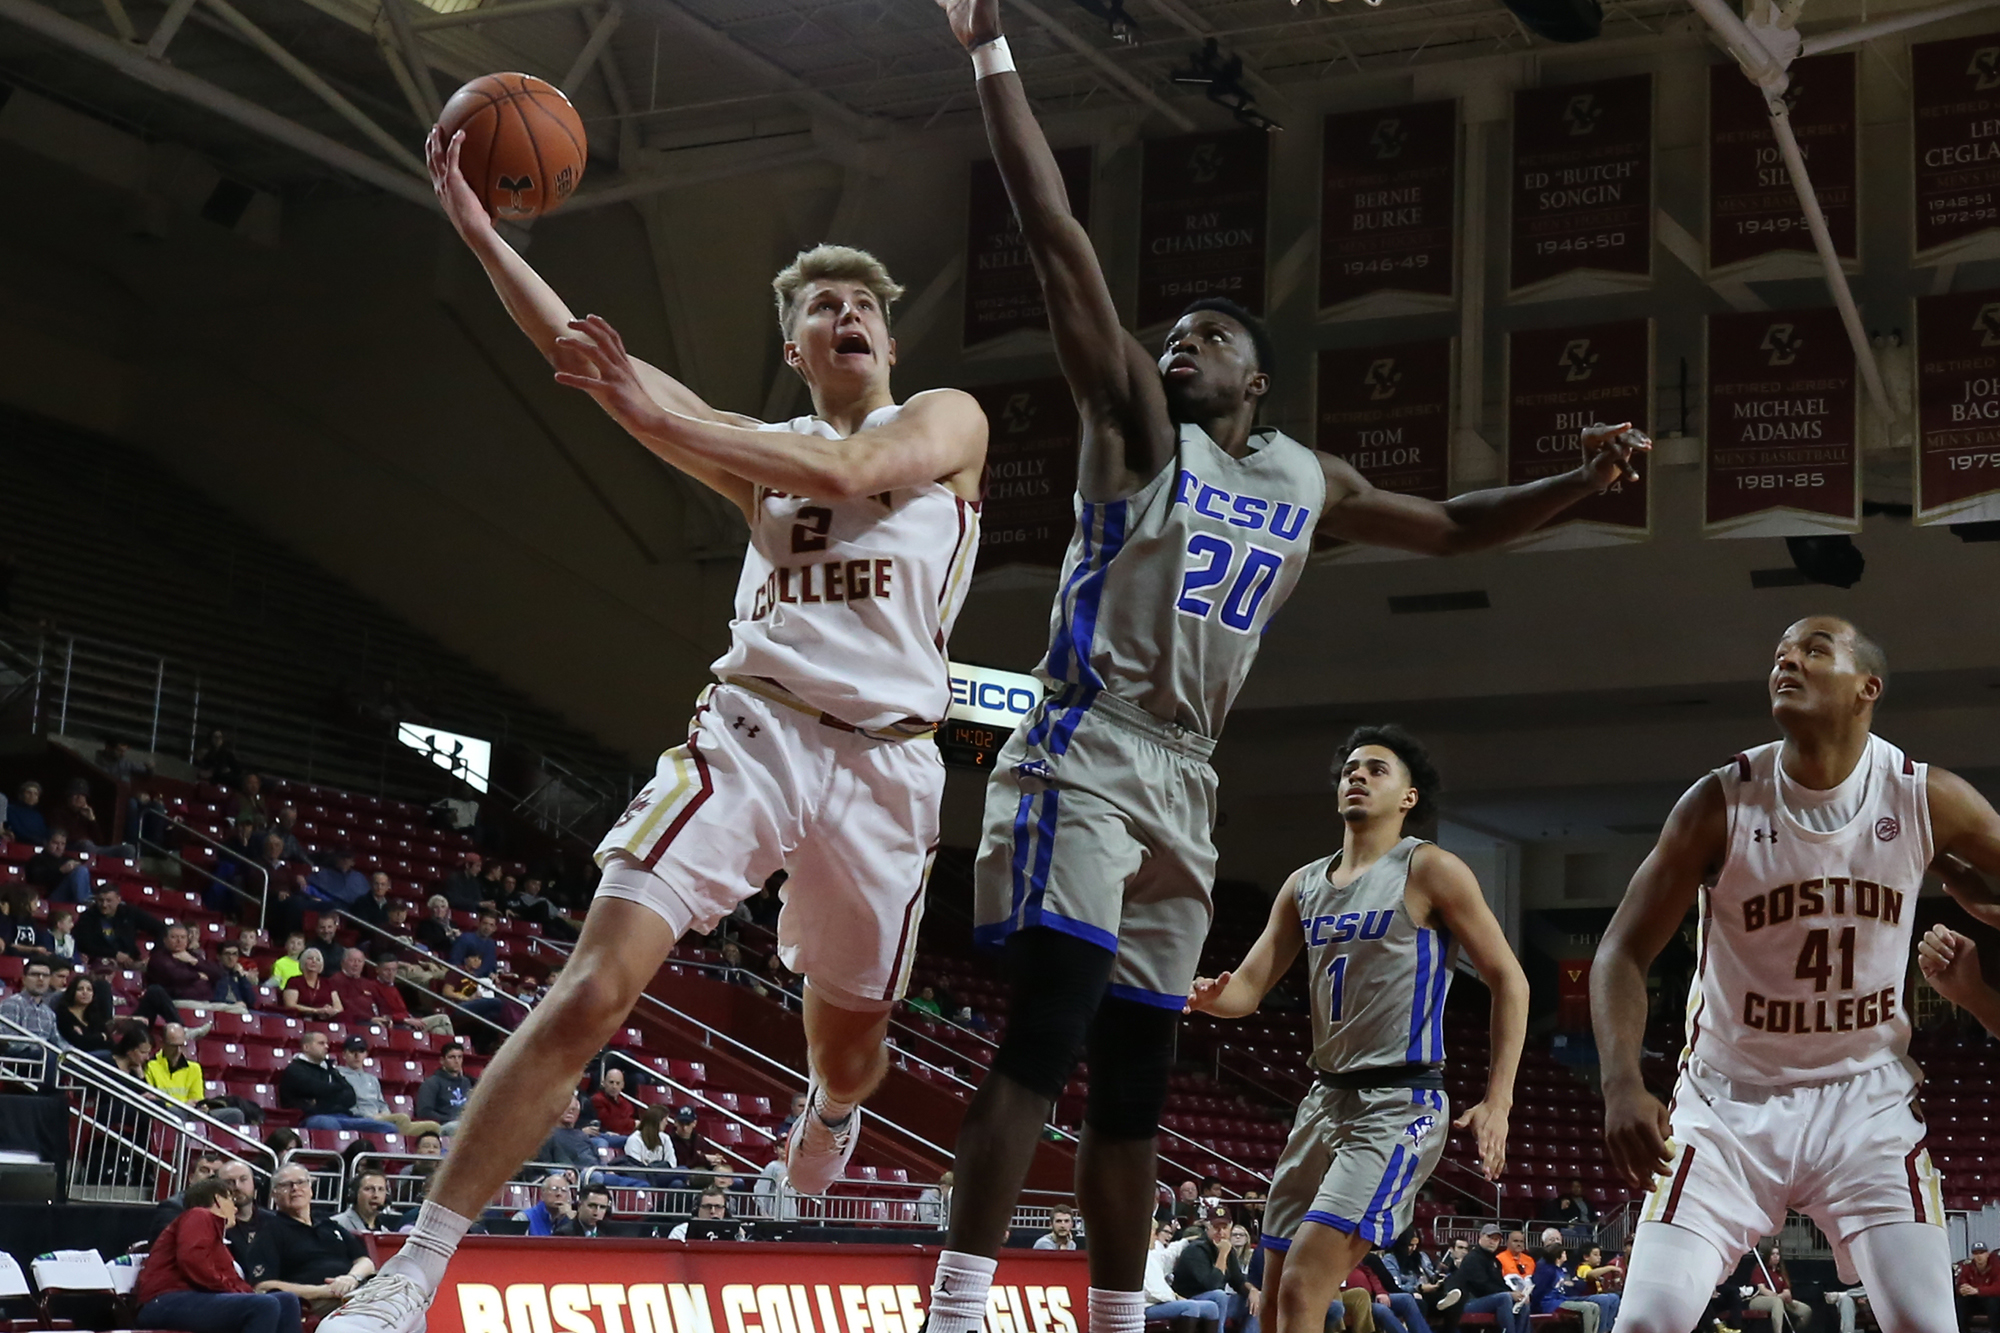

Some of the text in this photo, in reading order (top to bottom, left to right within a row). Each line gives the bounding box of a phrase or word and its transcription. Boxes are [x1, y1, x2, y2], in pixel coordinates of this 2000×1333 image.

[1716, 123, 1848, 143] RETIRE ERSEY
[1524, 172, 1549, 190] ED
[1758, 167, 1791, 187] SIL
[1354, 187, 1421, 209] BERNIE
[1539, 183, 1622, 210] SONGIN
[1186, 212, 1220, 230] RAY
[1353, 207, 1423, 230] BURKE
[1152, 228, 1254, 255] CHAISSON
[1536, 232, 1625, 254] 1946-50
[1344, 254, 1429, 275] 1946-49
[1160, 277, 1242, 296] 1940-42
[1714, 382, 1781, 395] RETIRED
[1734, 398, 1829, 418] MICHAEL
[1357, 427, 1403, 448] TOM
[1741, 420, 1822, 442] ADAMS
[1536, 435, 1581, 453] CUR
[1713, 448, 1848, 466] MEN'S BASKETBALL
[986, 458, 1047, 479] MOLLY
[986, 479, 1051, 500] CHAUS
[1736, 472, 1825, 489] 1981-85
[792, 506, 833, 554] 2
[1174, 531, 1284, 634] 20
[951, 677, 1036, 715] EICO
[955, 727, 994, 748] 14:02
[1743, 876, 1904, 932] BOSTON
[1795, 925, 1856, 993] 41
[1326, 953, 1350, 1024] 1
[1744, 986, 1896, 1034] COLLEGE
[456, 1283, 716, 1333] BOSTON
[721, 1284, 926, 1333] COLLEGE
